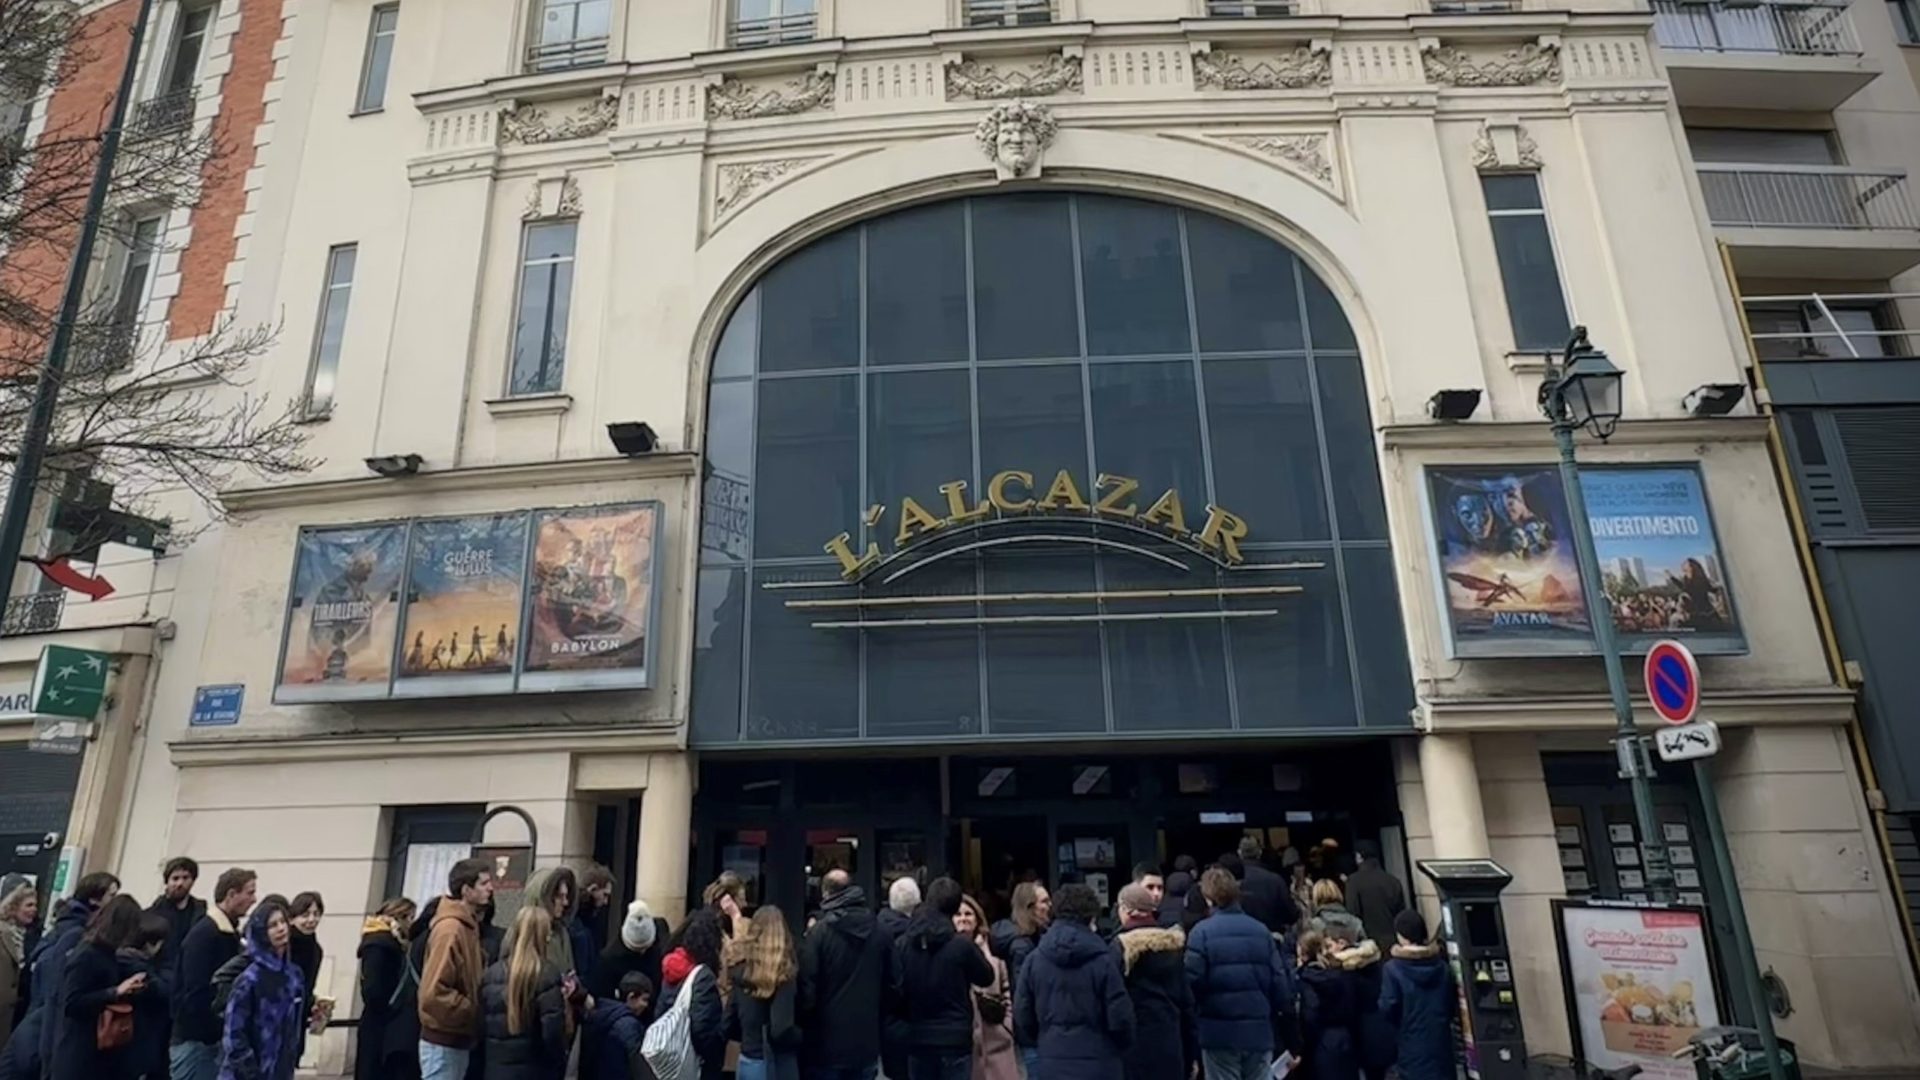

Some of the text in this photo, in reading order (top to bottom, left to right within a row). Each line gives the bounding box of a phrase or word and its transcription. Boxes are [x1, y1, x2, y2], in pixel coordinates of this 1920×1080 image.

[824, 469, 1250, 583] L'ALCAZAR
[1590, 516, 1699, 536] DIVERTIMENTO
[443, 549, 494, 565] GUERRE
[313, 601, 373, 621] TIRAILLEURS
[1493, 611, 1552, 625] AVATAR
[551, 639, 621, 654] BABYLON
